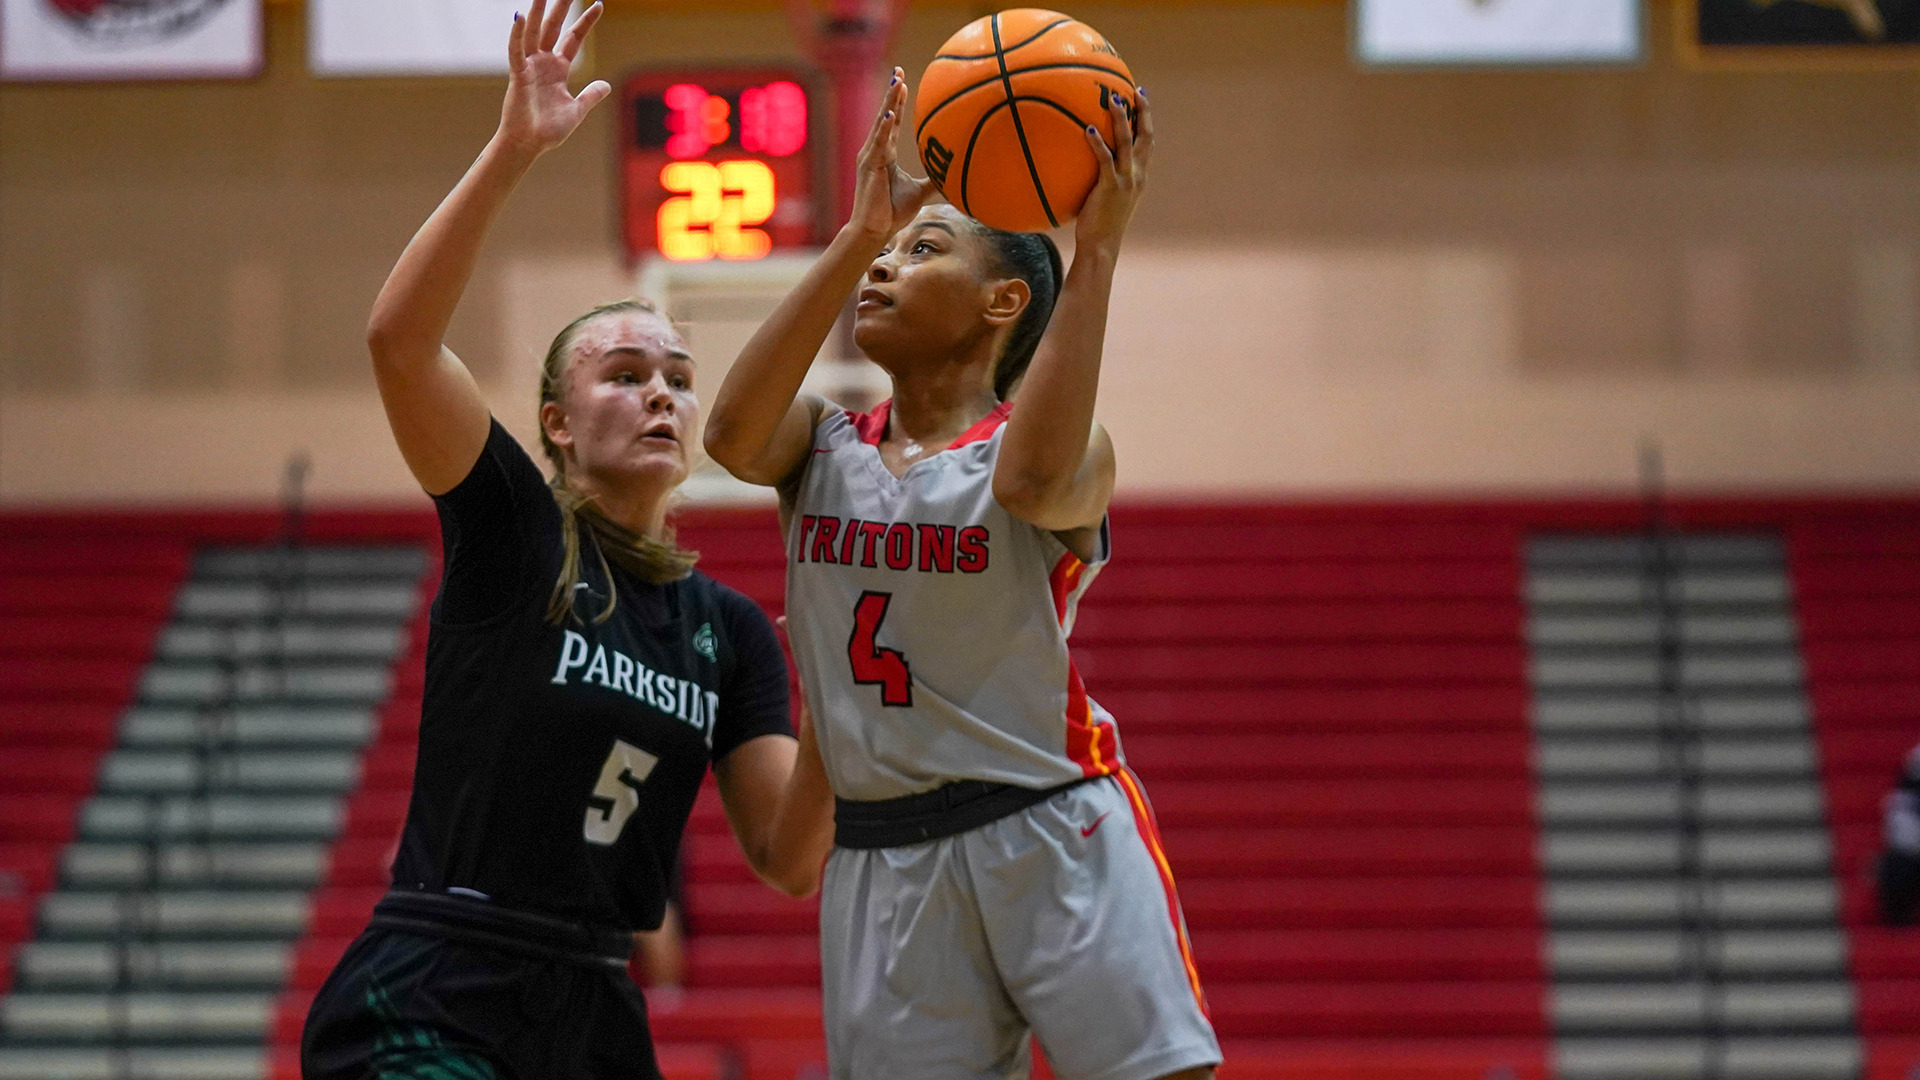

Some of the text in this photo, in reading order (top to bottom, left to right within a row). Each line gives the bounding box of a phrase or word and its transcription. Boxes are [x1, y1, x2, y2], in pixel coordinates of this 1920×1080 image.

[657, 160, 776, 263] 22
[798, 514, 990, 574] TRITONS
[848, 590, 914, 708] 4
[583, 738, 659, 846] 5
